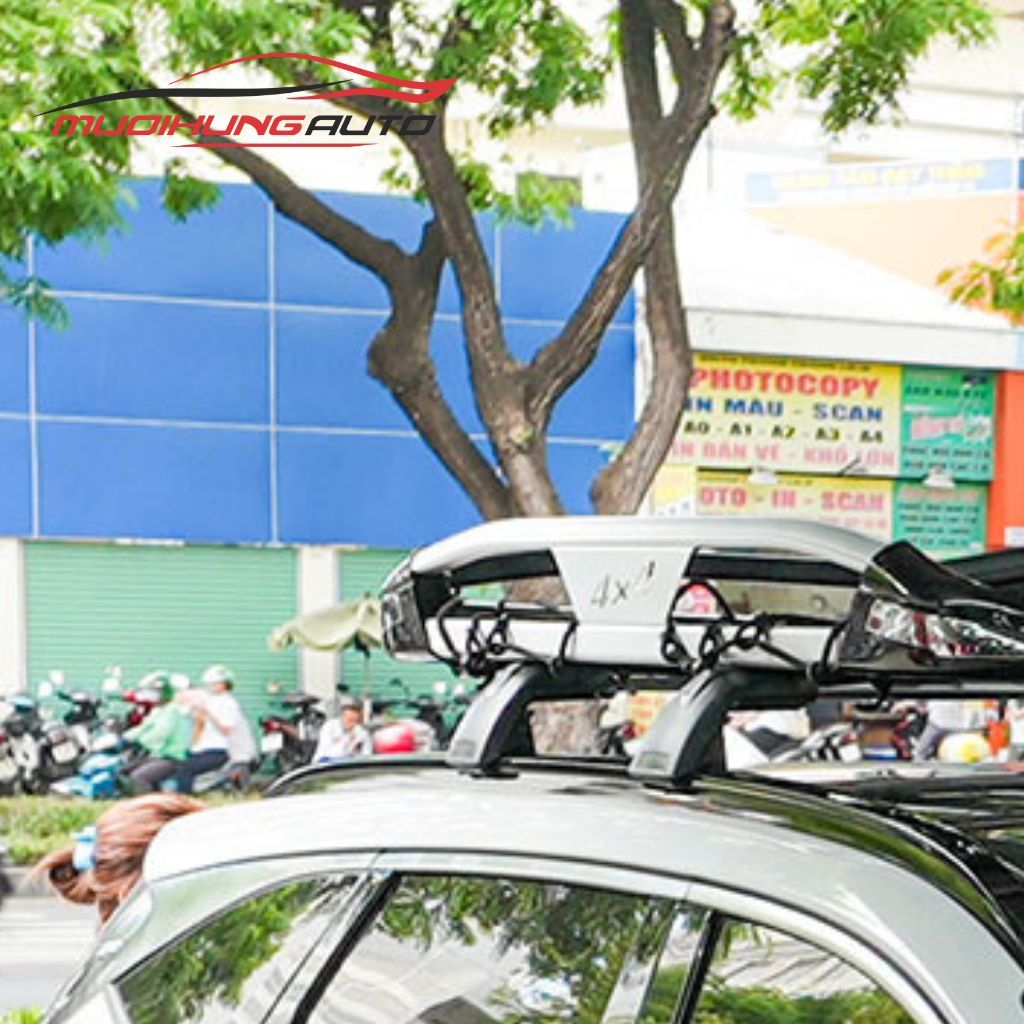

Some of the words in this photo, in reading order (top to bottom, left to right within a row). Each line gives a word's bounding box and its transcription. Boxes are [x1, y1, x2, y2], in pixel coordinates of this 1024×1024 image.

[690, 368, 880, 398] PHOTOCOPY
[813, 403, 882, 421] SCAN
[821, 491, 884, 511] SCAN
